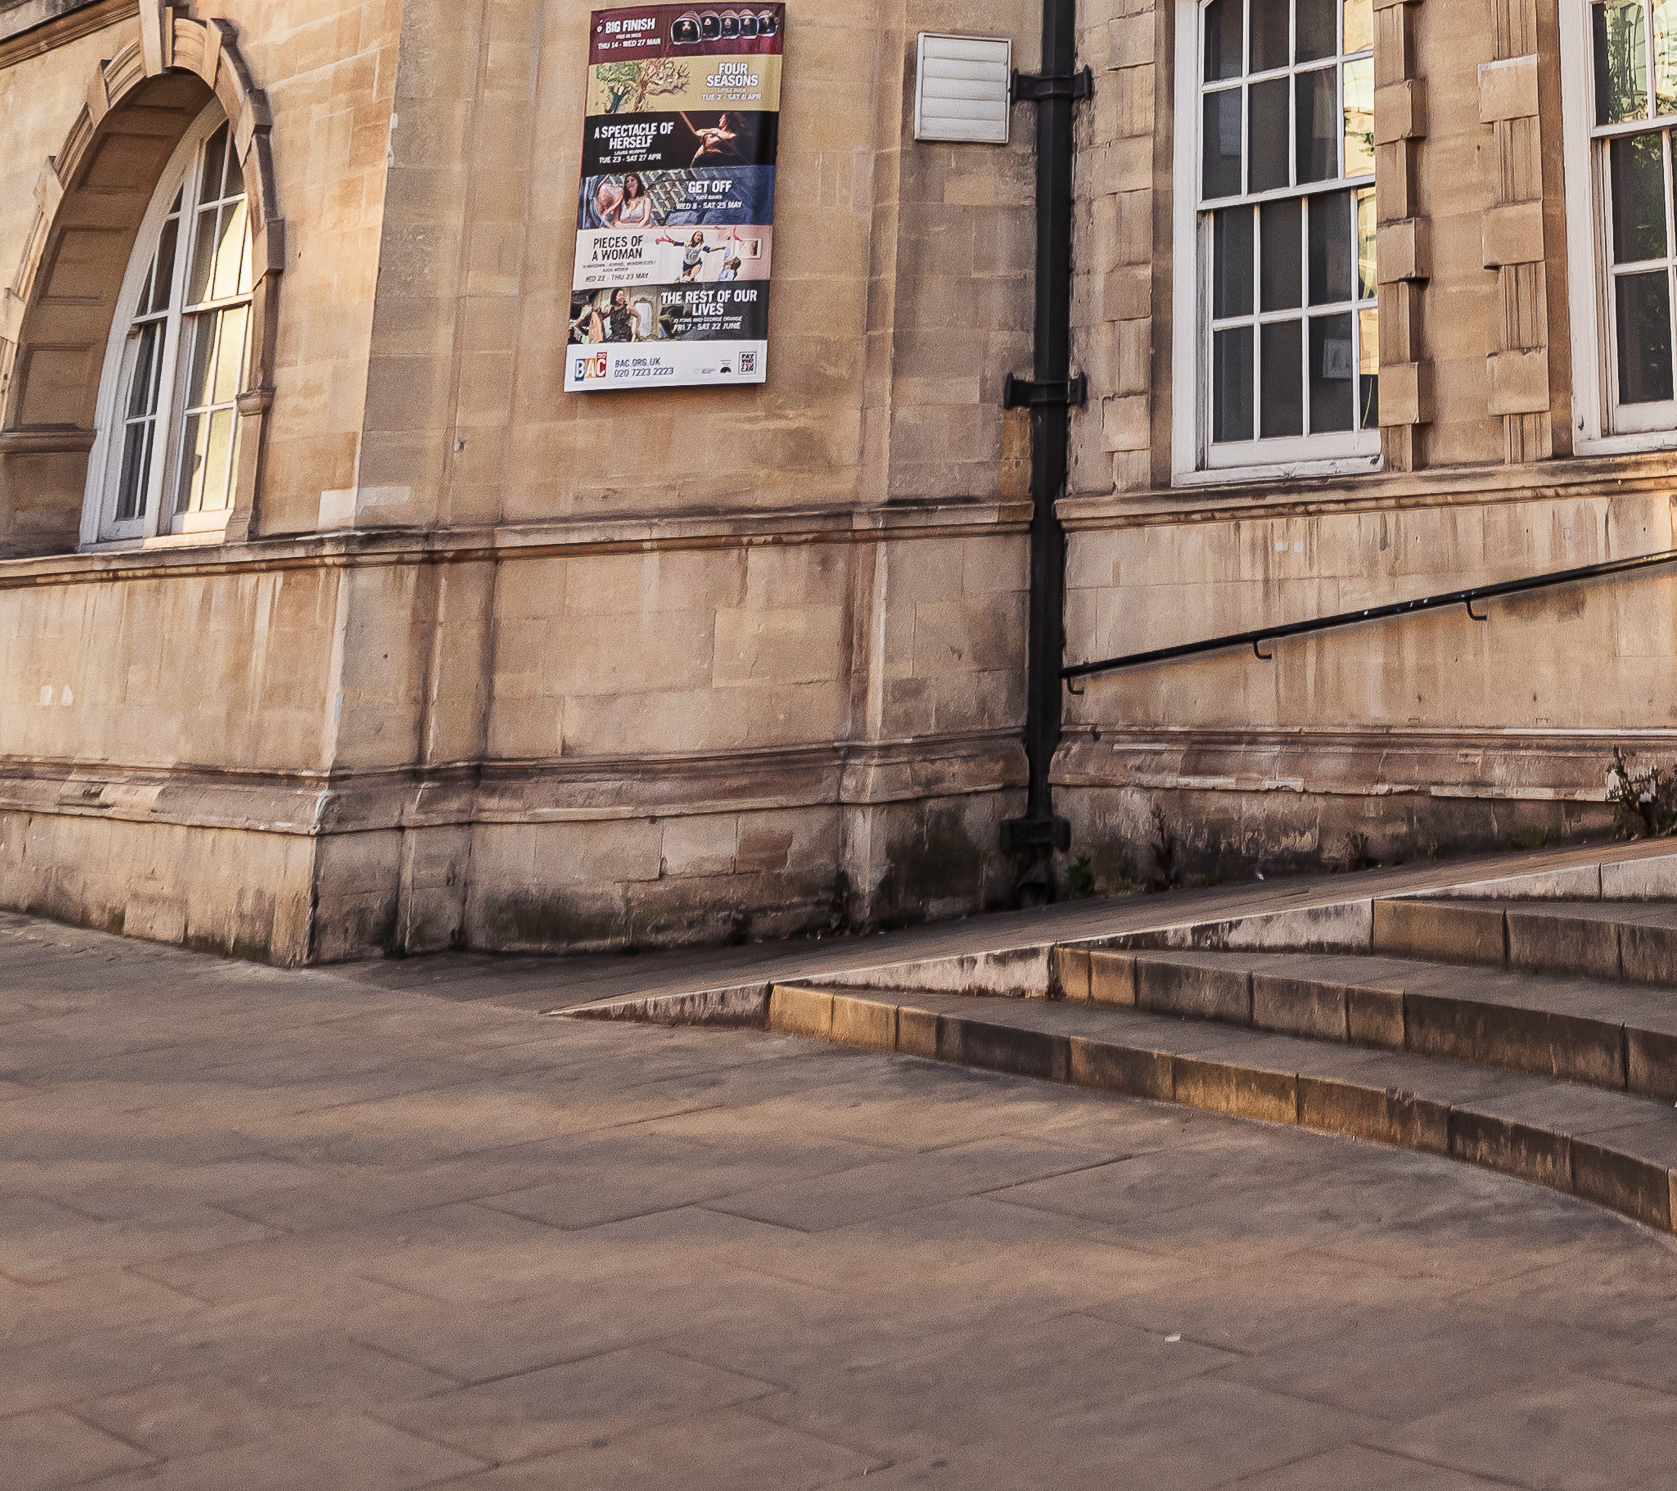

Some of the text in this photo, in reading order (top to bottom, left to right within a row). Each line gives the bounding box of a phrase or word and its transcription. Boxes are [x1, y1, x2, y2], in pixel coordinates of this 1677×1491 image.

[605, 17, 656, 34] BIG FINISH
[719, 62, 748, 75] FOUR
[706, 74, 759, 87] SEASONS
[594, 121, 675, 139] A SPECTACLE OF
[609, 135, 654, 150] HERSELF
[599, 156, 612, 164] TUE
[688, 179, 732, 194] GET OFF
[716, 201, 726, 209] 25
[727, 200, 743, 208] MAY
[593, 234, 644, 249] PIECES OF
[591, 247, 643, 262] A WOMAN
[611, 273, 625, 281] THU
[661, 289, 758, 304] THE REST OF OUR
[692, 303, 724, 316] LIVES
[697, 323, 710, 331] SAT
[722, 322, 741, 330] JUNE
[575, 358, 607, 378] BAC
[614, 358, 661, 367] BAC.ORG.UK
[614, 367, 674, 378] 020 7223 2223
